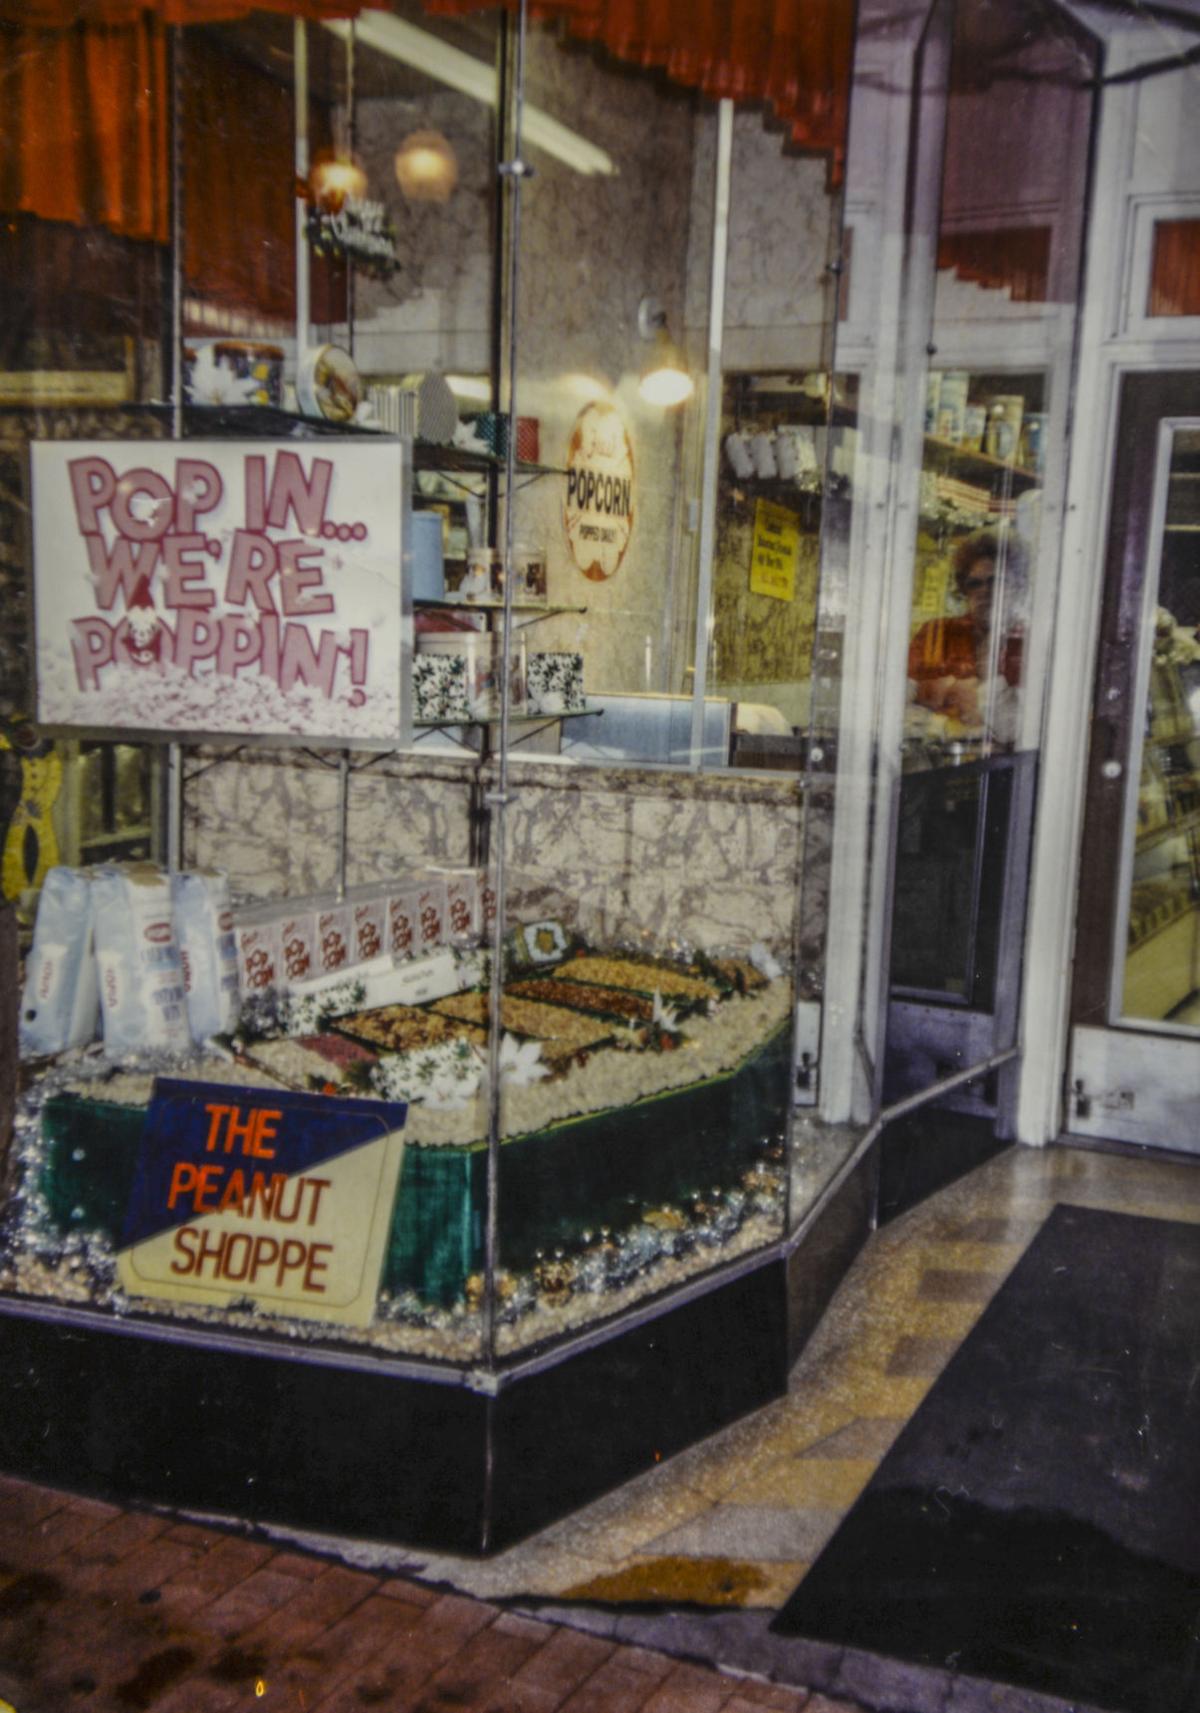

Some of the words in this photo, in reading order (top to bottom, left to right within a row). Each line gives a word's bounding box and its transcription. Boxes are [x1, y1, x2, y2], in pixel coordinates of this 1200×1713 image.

[67, 456, 223, 542] POP
[244, 449, 368, 541] IN...
[567, 467, 631, 516] POPCORN
[85, 528, 335, 616] WE'RE
[205, 1104, 282, 1159] THE
[166, 1162, 331, 1227] PEANUT
[170, 1227, 334, 1294] SHOPPE
